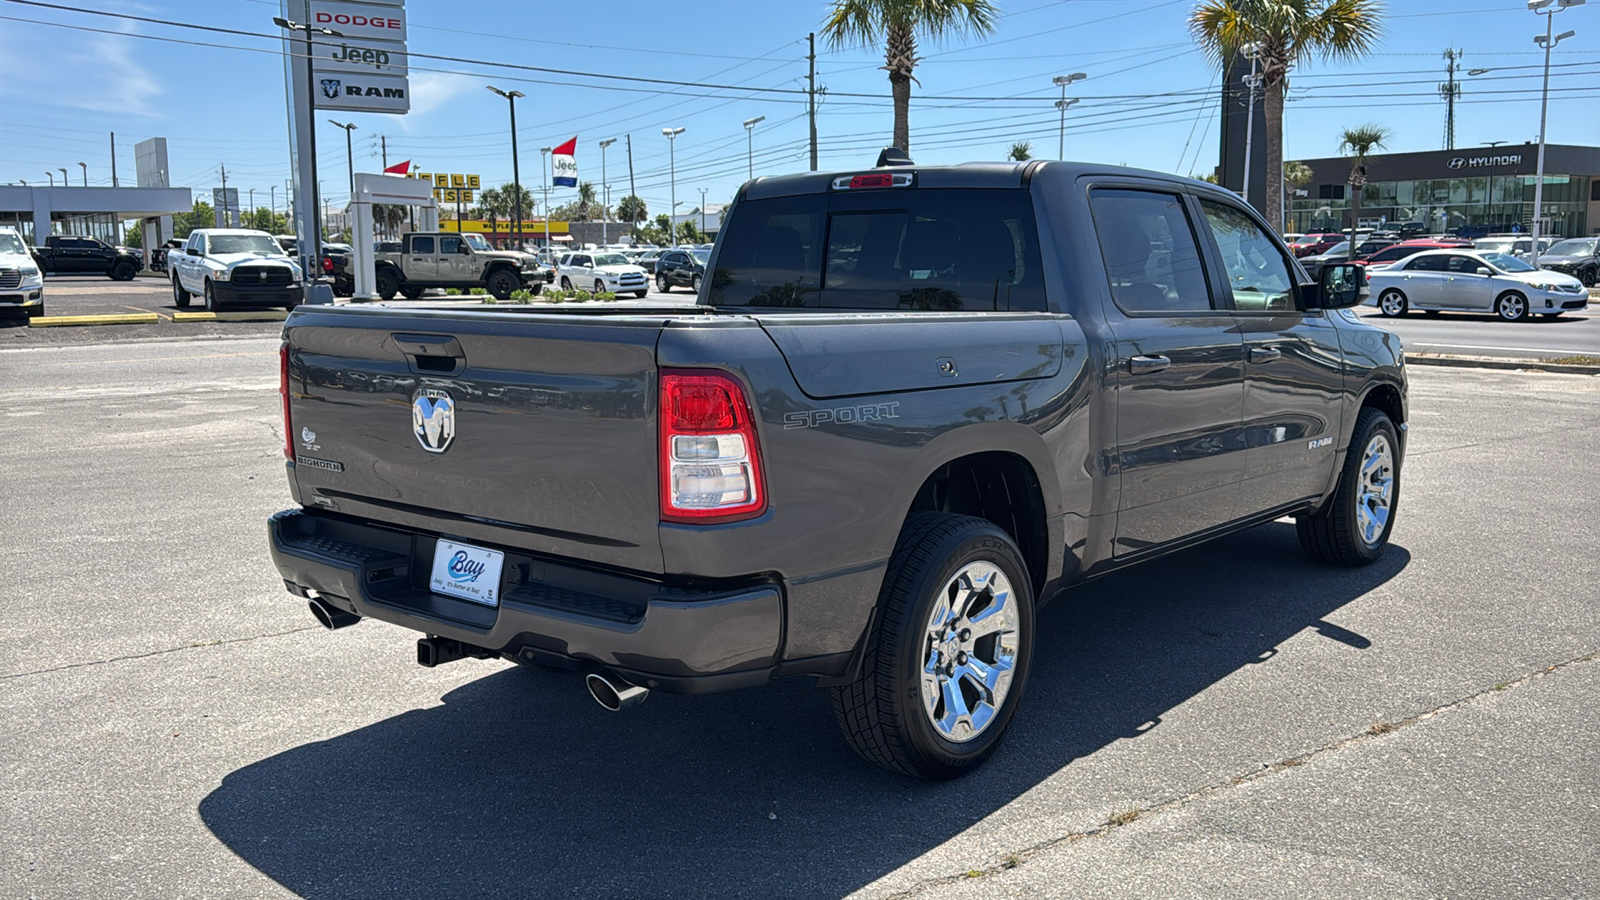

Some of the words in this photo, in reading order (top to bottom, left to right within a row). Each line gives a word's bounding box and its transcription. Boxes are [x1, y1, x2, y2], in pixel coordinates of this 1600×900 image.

[316, 12, 402, 30] DODGE
[332, 43, 389, 69] Jeep
[346, 85, 404, 99] RAM
[555, 160, 577, 173] Jeep
[1469, 154, 1522, 168] HYUNDAI
[783, 402, 900, 430] SPORT
[1308, 437, 1333, 450] RAM
[297, 456, 341, 472] BIGHORN
[450, 550, 486, 583] Bay
